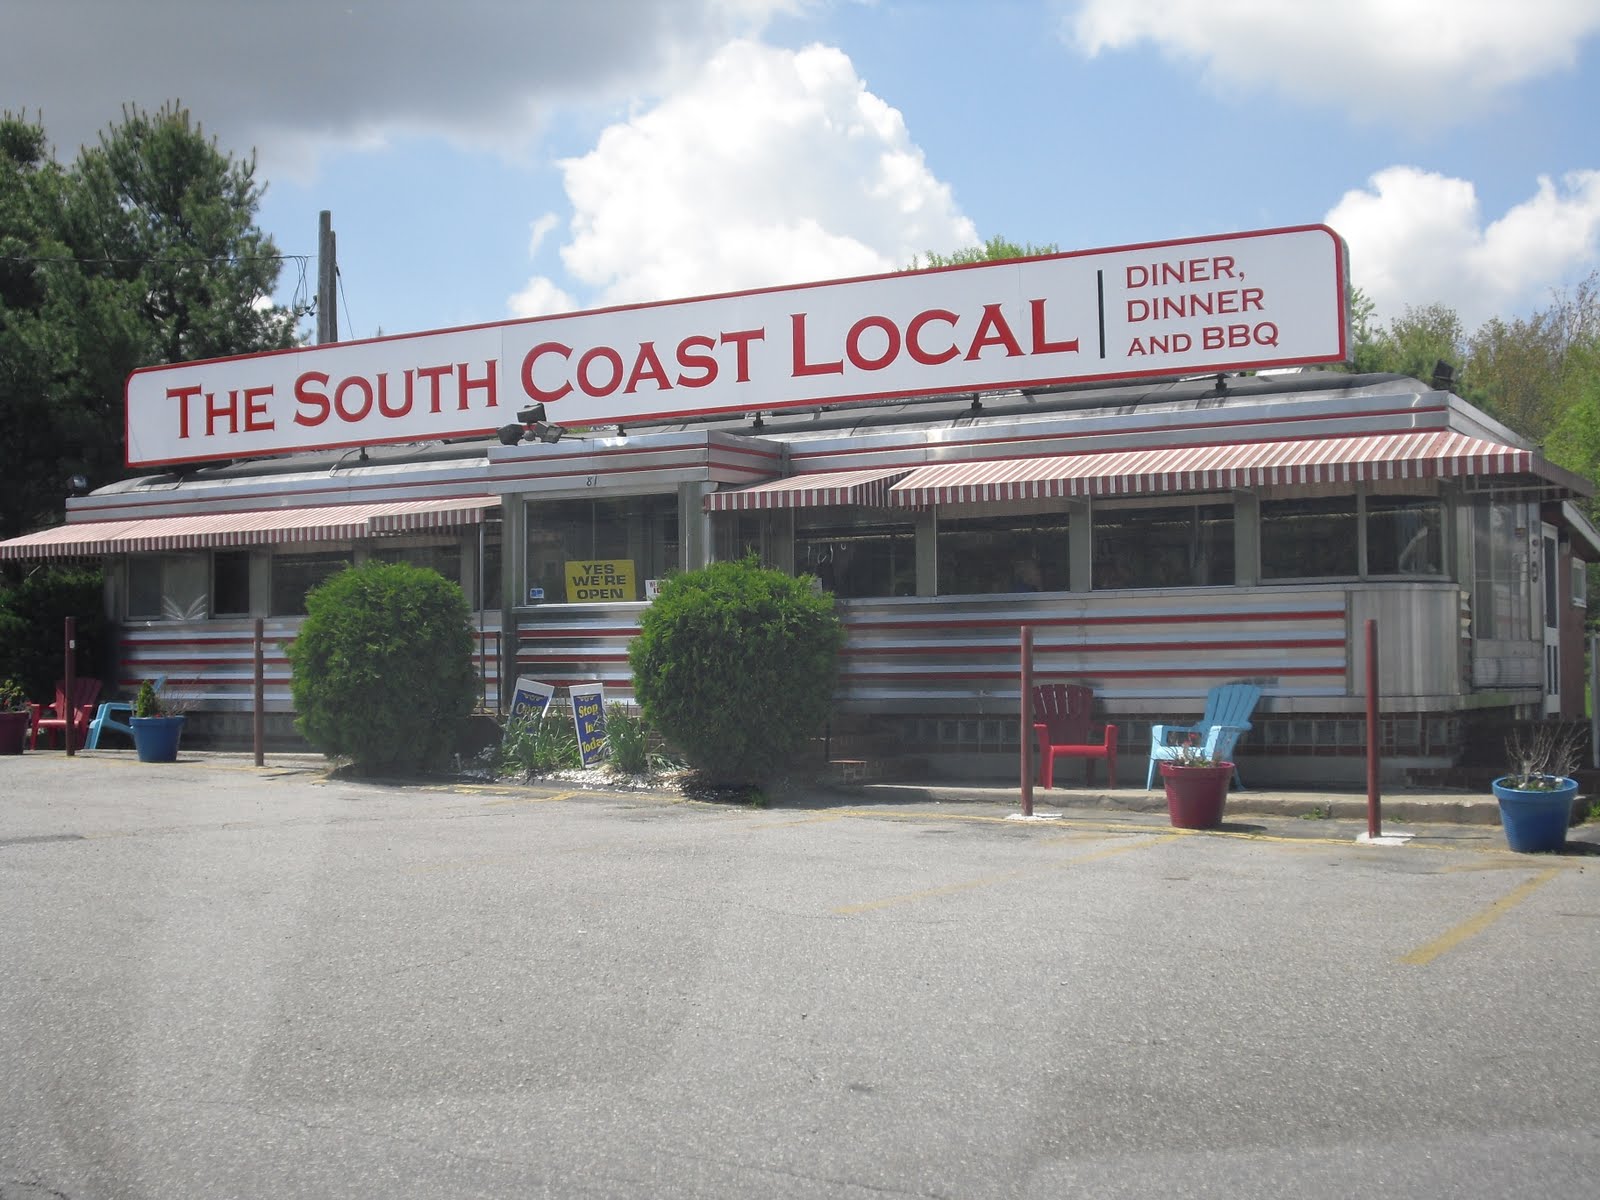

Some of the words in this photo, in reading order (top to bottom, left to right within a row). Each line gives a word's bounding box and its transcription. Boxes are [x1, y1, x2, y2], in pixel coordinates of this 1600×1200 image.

[1126, 255, 1246, 289] DINER,
[1126, 287, 1266, 323] DINNER
[1126, 333, 1193, 357] AND
[1202, 321, 1280, 350] BBQ
[166, 383, 276, 439] THE
[293, 359, 499, 428] SOUTH
[520, 327, 766, 403] COAST
[790, 298, 1080, 378] LOCAL
[586, 476, 598, 487] 81
[582, 563, 615, 575] YES
[572, 575, 626, 587] WE'RE
[576, 588, 624, 600] OPEN
[578, 703, 598, 719] Stop
[585, 721, 594, 734] In
